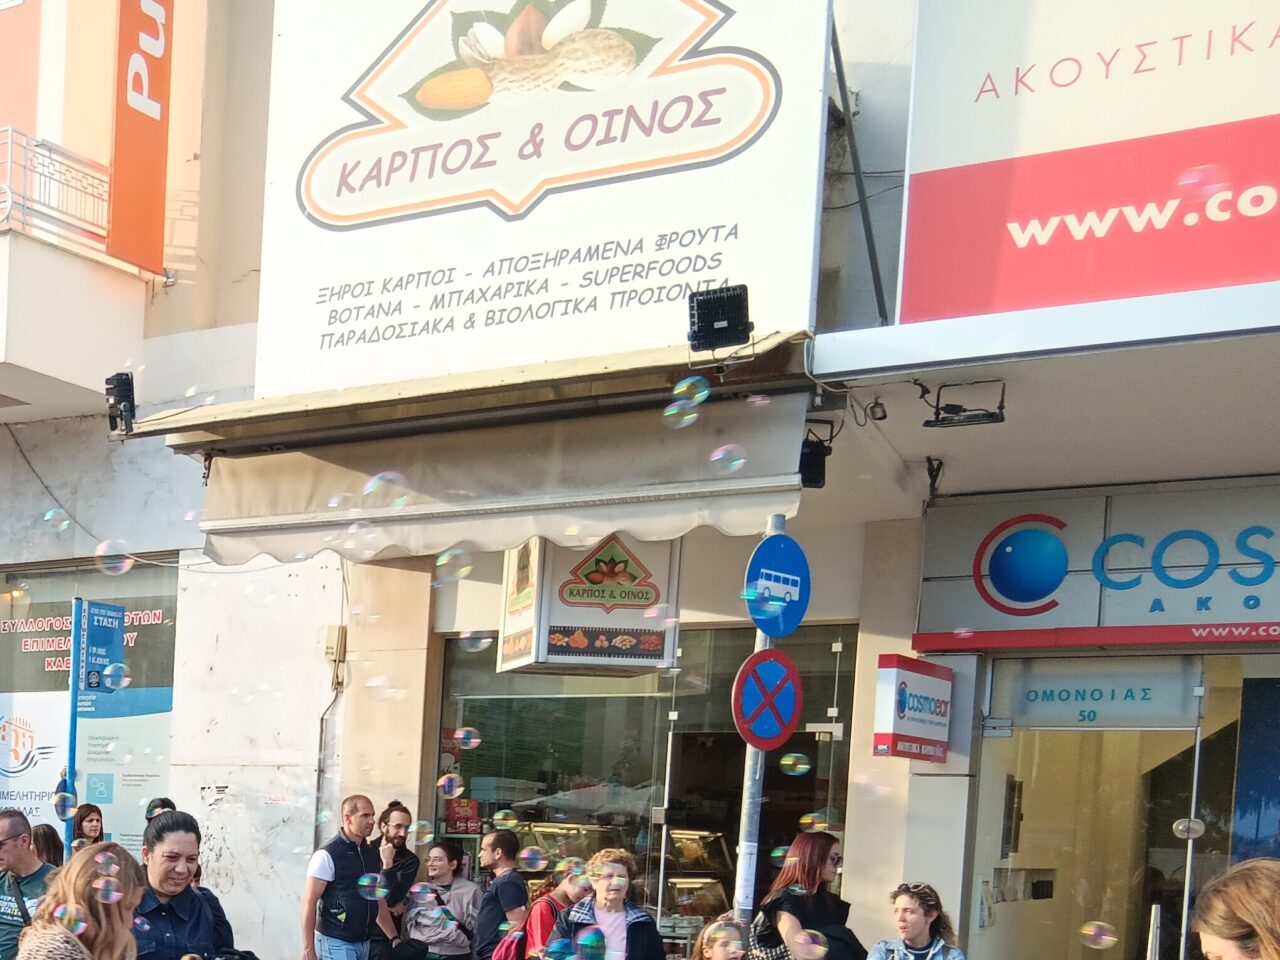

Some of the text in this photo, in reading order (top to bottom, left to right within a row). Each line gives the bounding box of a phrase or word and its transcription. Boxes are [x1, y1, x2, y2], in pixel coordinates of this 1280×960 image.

[336, 87, 728, 197] ΚΑΡΠΟΣ & ΟΙΝΟΣ
[1006, 184, 1279, 249] www.co
[315, 280, 375, 305] ΞΗΡΟΙ
[380, 267, 457, 295] ΚΑΡΠΟΙ
[482, 237, 644, 278] ΑΠΟΞΗΡΑΜΕΝΑ
[654, 223, 739, 252] ΦΡΟΥΤΑ
[327, 300, 402, 326] ΒΟΤΑΝΑ
[429, 278, 549, 311] ΜΠΑΧΑΡΙΚΑ
[579, 252, 724, 289] SUPERFOODS
[319, 317, 455, 351] ΠΑΡΑΔΟΣΙΑΚΑ
[463, 312, 476, 330] &
[484, 296, 598, 327] ΒΙΟΛΟΓΙΚΑ
[568, 588, 606, 599] ΚΑΡΠΟΣ
[619, 590, 650, 600] ΟΙΝΟΣ
[93, 616, 119, 629] ΣΤΑΣΗ
[1025, 687, 1152, 703] ΟΜΟΝΟΙΑΣ
[1077, 709, 1097, 723] 50
